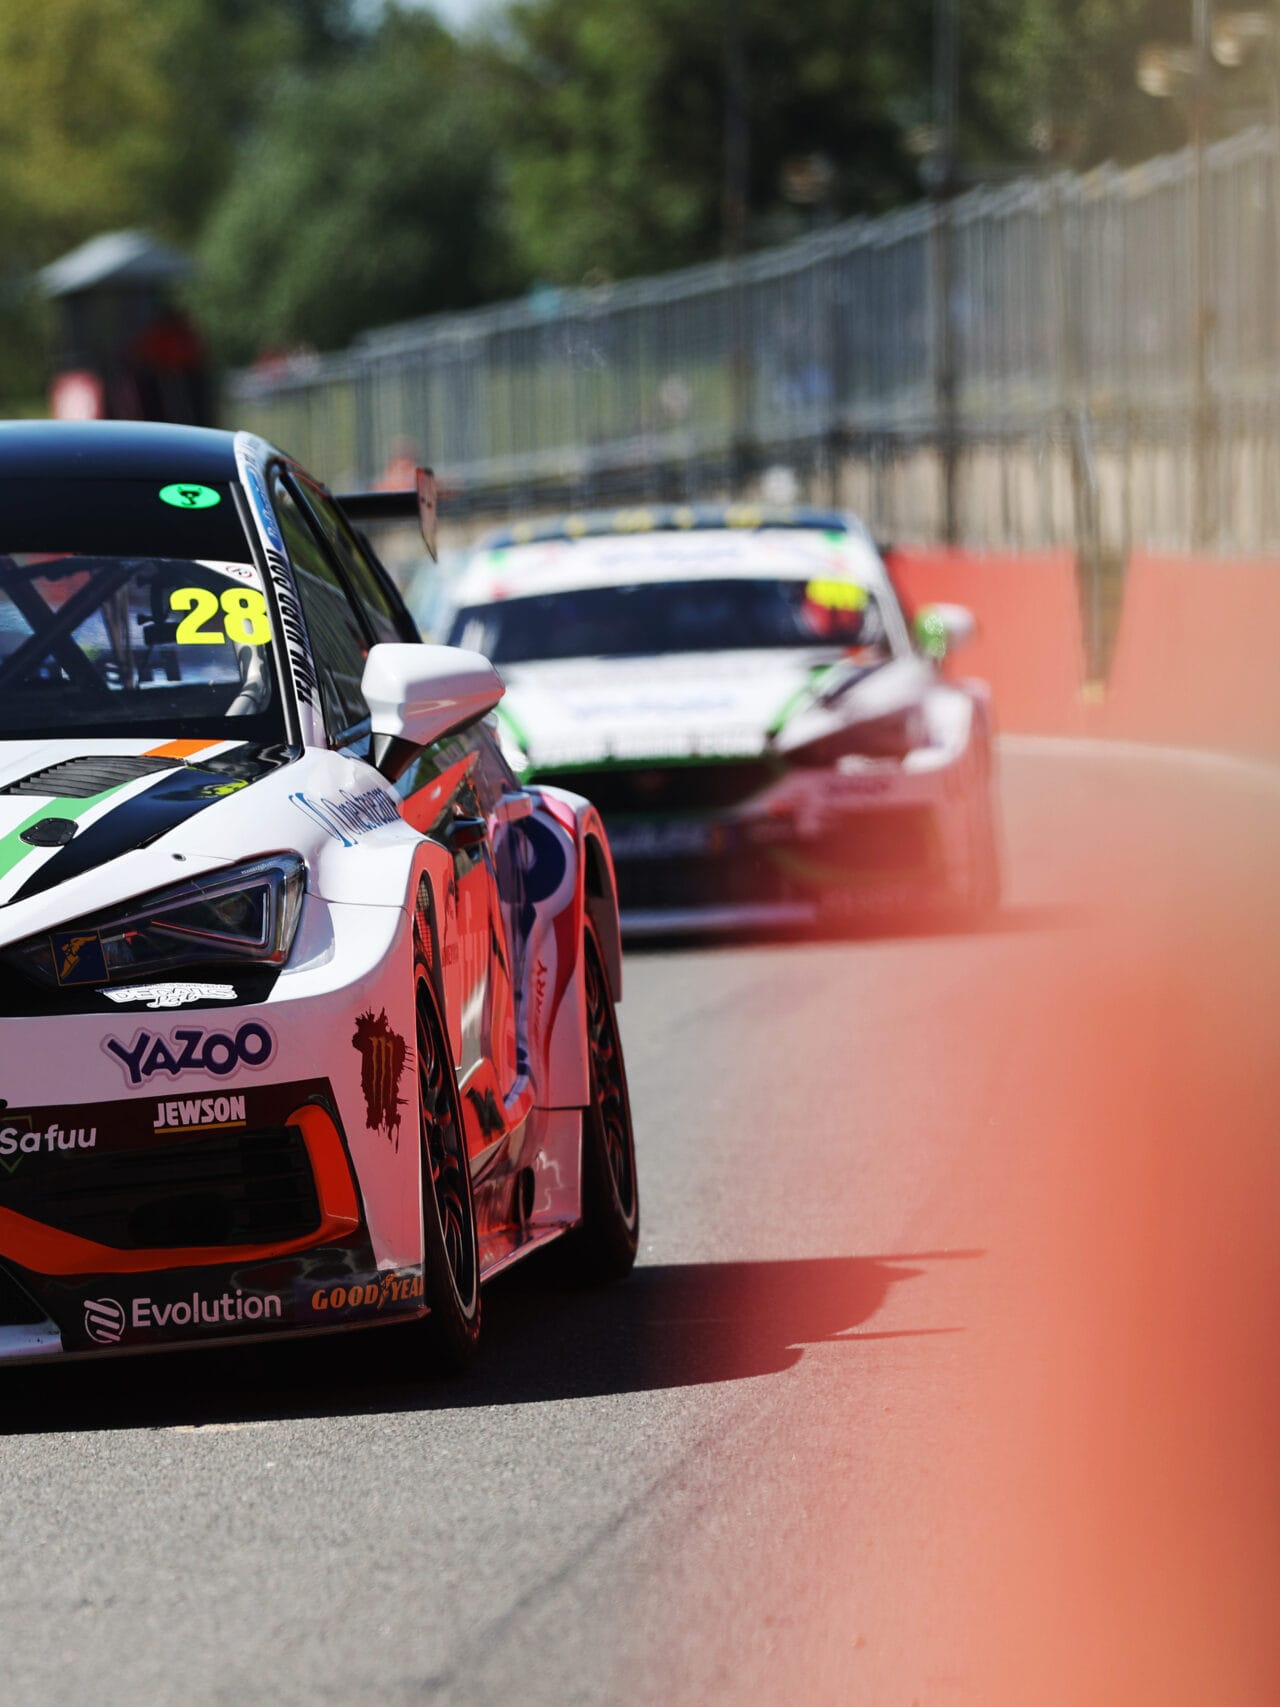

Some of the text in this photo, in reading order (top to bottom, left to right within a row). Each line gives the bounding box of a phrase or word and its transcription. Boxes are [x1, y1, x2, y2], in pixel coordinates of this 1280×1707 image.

[169, 587, 272, 646] 28
[107, 1022, 273, 1083] YAZOO
[153, 1096, 247, 1128] JEWSON
[132, 1290, 282, 1329] Evolution
